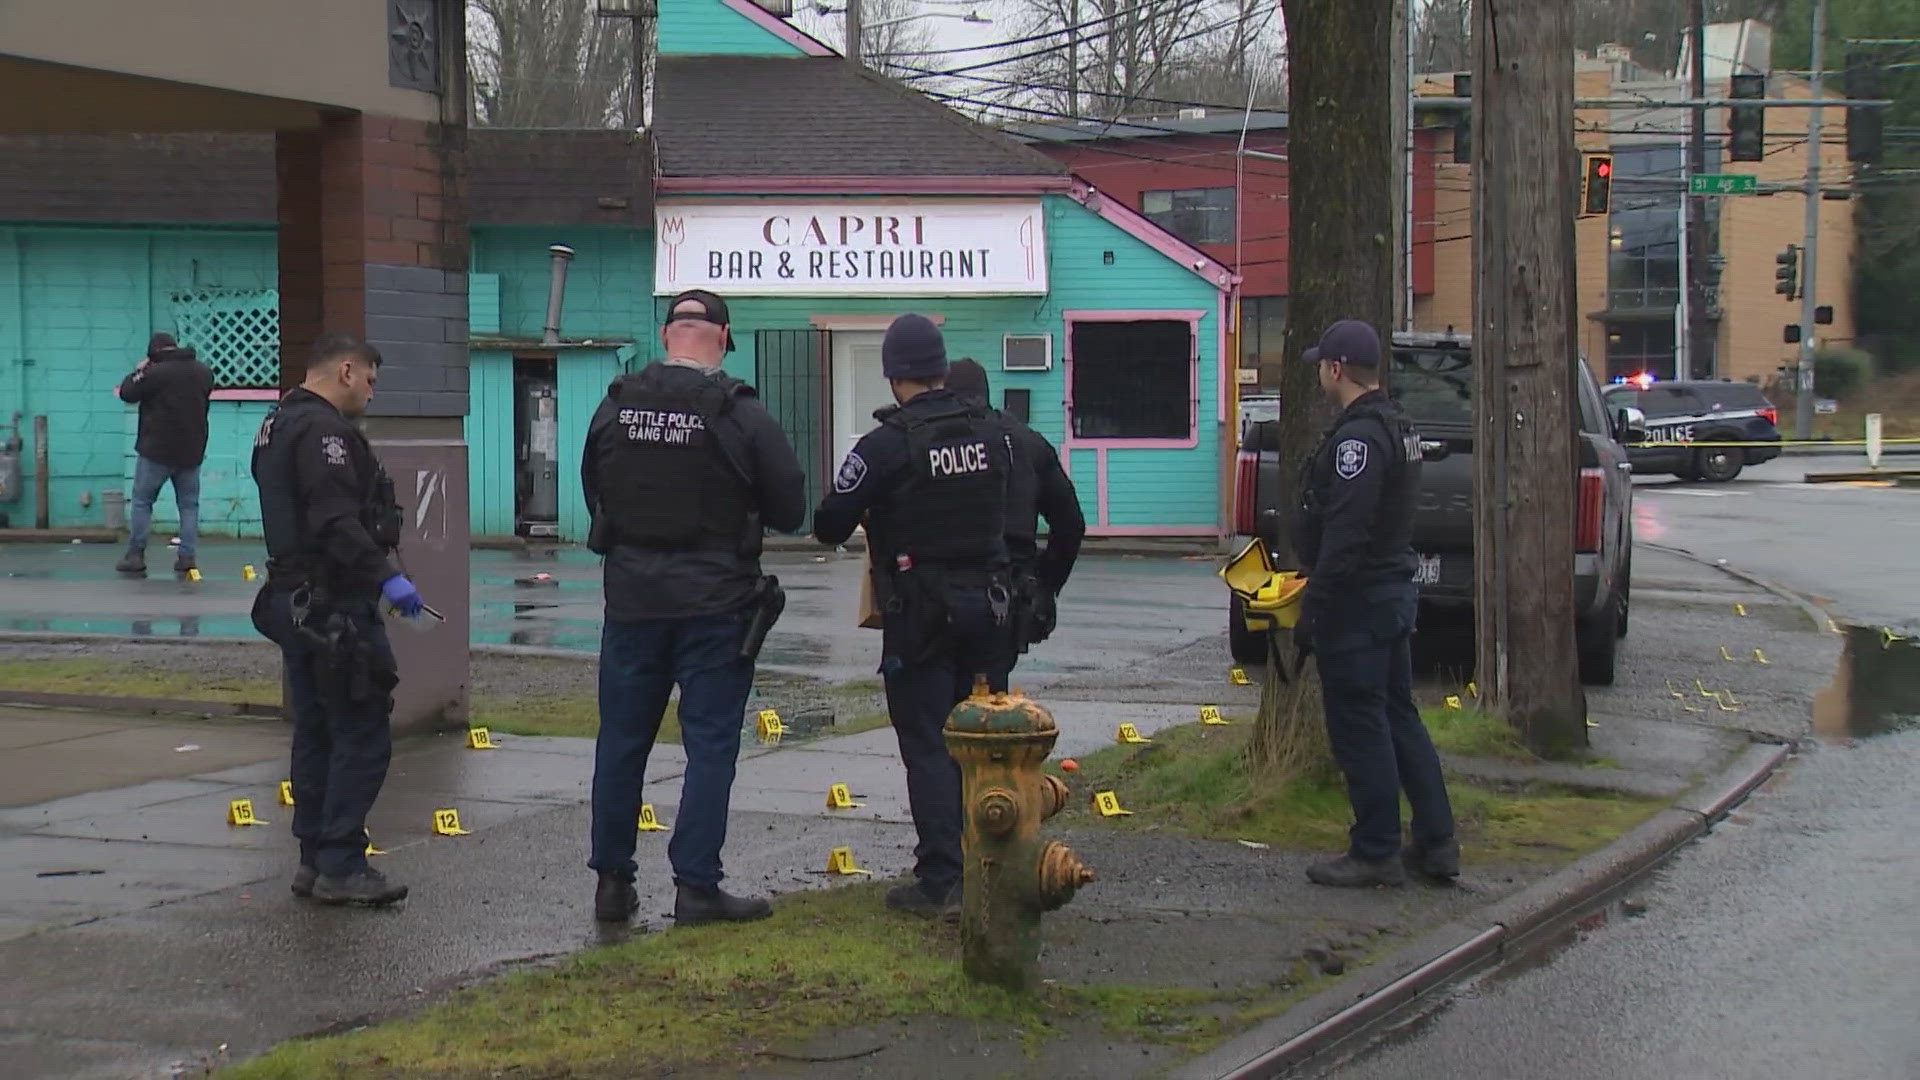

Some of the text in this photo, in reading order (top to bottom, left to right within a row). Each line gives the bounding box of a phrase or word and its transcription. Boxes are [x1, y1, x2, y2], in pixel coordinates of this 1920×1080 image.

[762, 215, 925, 247] CAPRI
[708, 249, 990, 280] BAR & RESTAURANT
[619, 408, 667, 428] SEATTLE
[628, 424, 692, 445] GANG UNIT
[929, 442, 989, 478] POLICE
[1203, 708, 1218, 720] 24
[767, 717, 779, 730] 19
[474, 731, 488, 744] 18
[837, 788, 846, 803] 9
[1103, 795, 1113, 810] 8
[235, 803, 251, 819] 15
[440, 813, 457, 829] 12
[838, 851, 847, 868] 7
